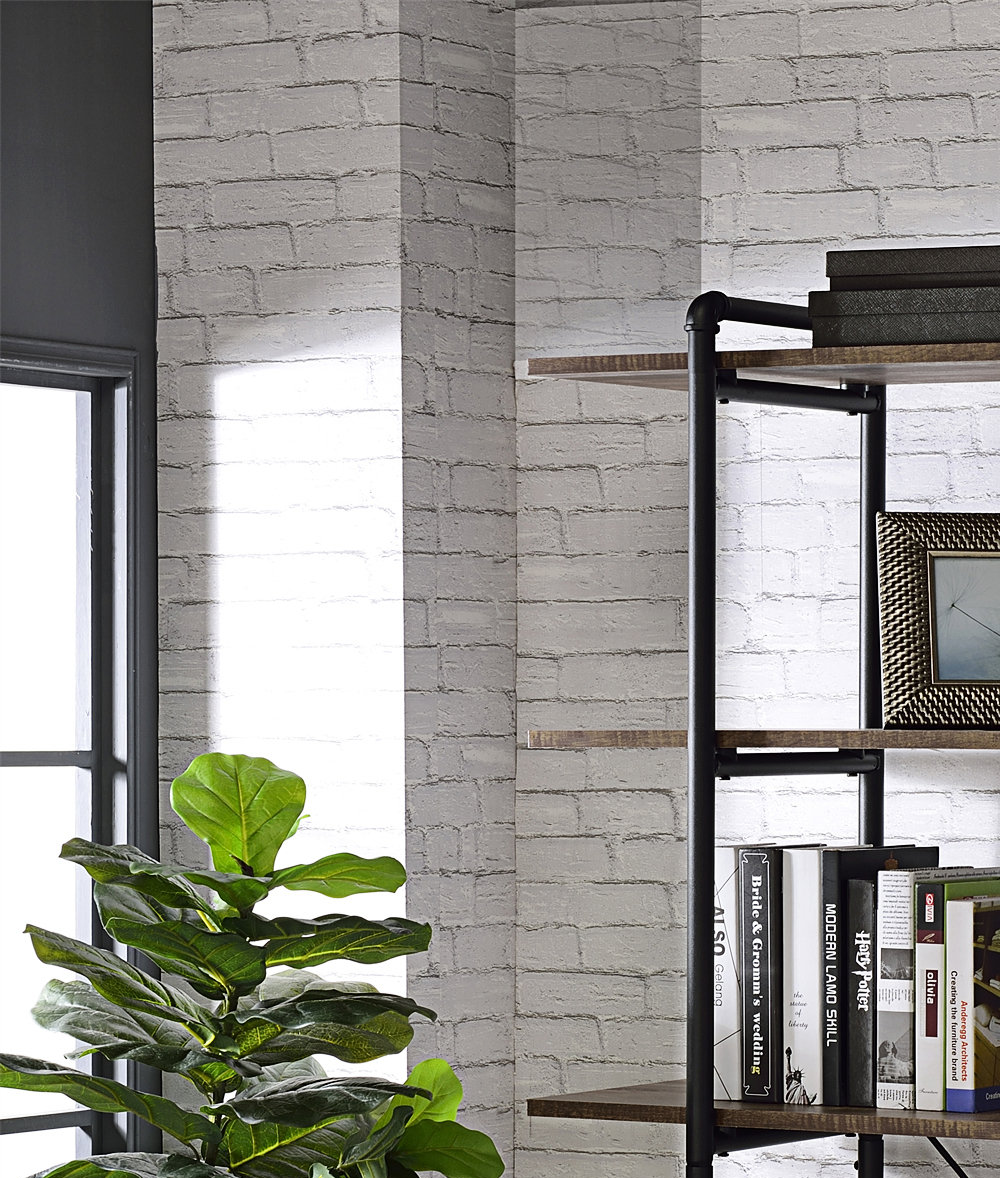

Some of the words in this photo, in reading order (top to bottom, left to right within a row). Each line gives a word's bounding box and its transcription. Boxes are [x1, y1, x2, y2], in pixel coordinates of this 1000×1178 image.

[751, 875, 762, 919] Bride
[752, 921, 762, 936] &
[825, 903, 837, 961] MODERN
[854, 930, 871, 970] Harry
[752, 938, 764, 1007] Gromm's
[825, 965, 837, 1005] LAMO
[851, 970, 873, 1012] Potter
[926, 972, 937, 1004] olivia
[949, 970, 958, 1005] Creating
[788, 1020, 809, 1030] liberty
[826, 1009, 838, 1047] SKILL
[951, 1022, 959, 1056] furniture
[959, 1000, 968, 1040] Anderegg
[750, 1012, 764, 1075] wedding
[960, 1041, 969, 1082] Architects
[951, 1058, 959, 1082] brand
